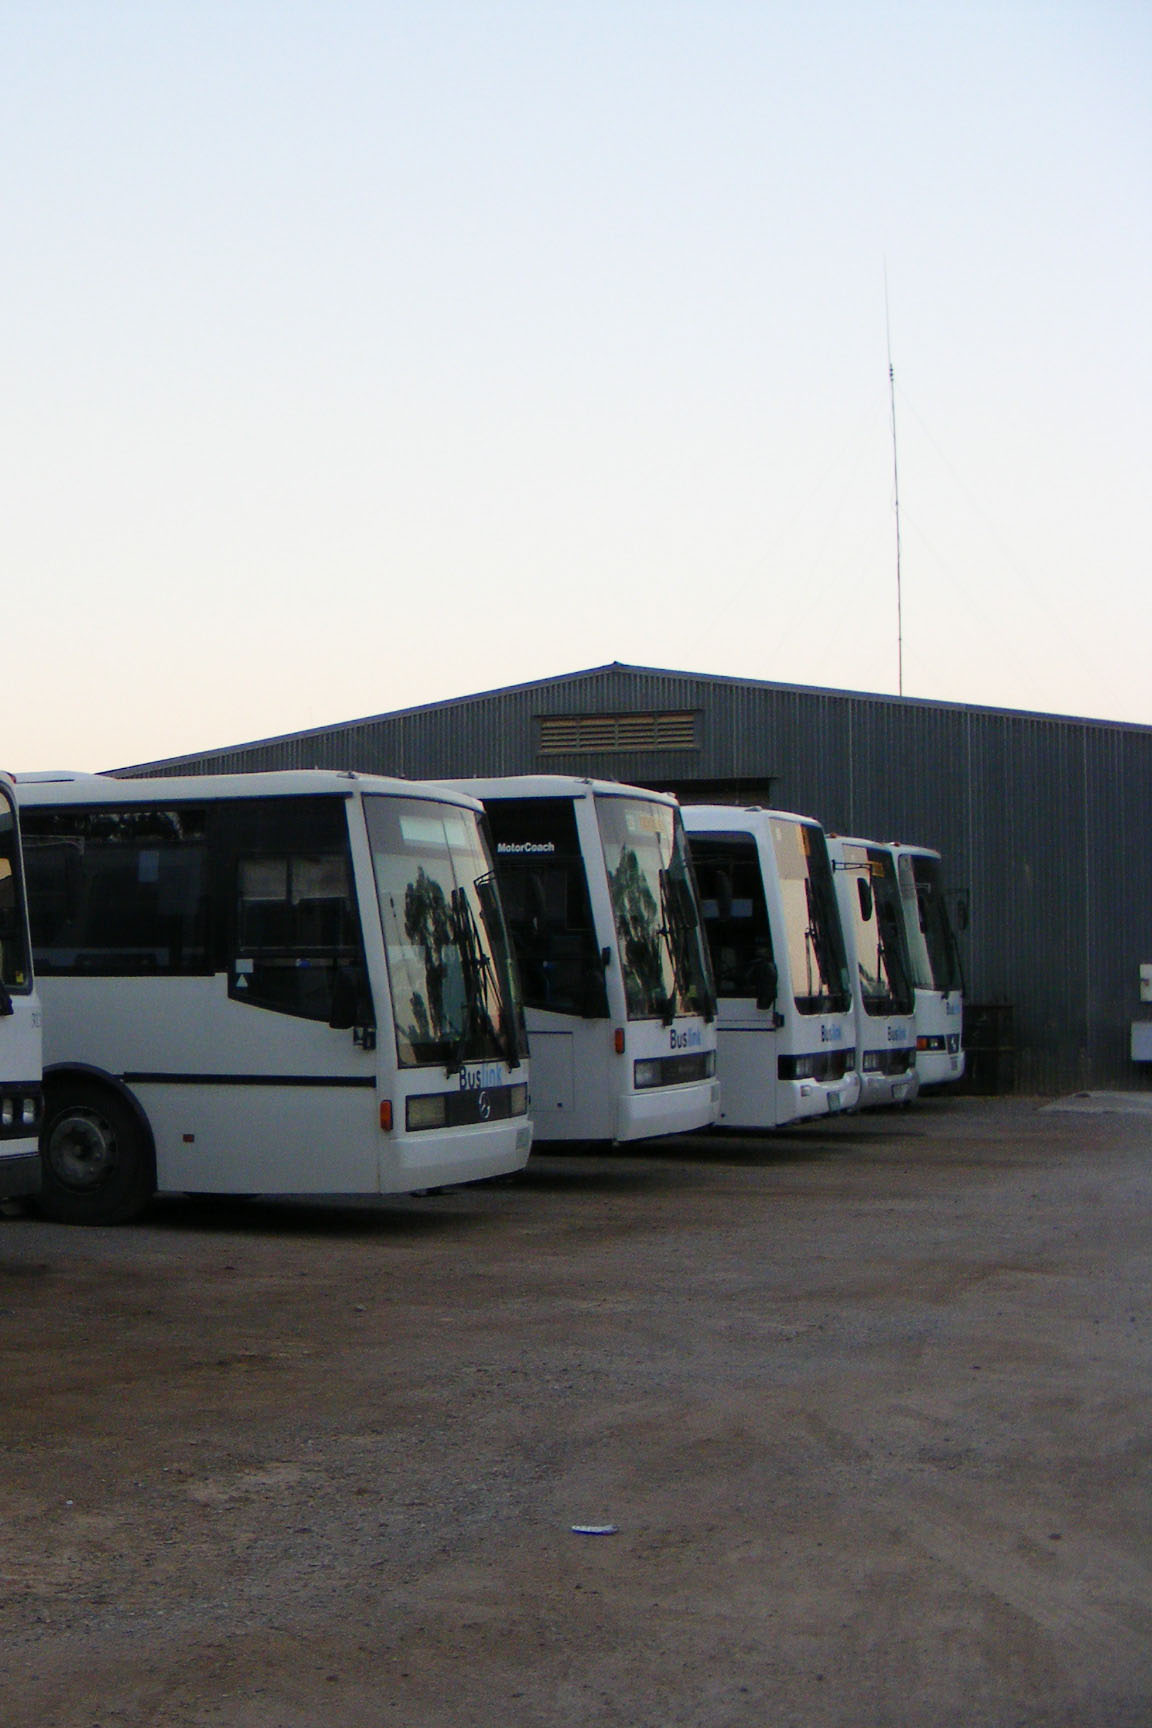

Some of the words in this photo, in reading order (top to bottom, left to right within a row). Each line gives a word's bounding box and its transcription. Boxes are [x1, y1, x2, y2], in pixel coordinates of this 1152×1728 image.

[496, 841, 555, 853] MotorCoach
[669, 1026, 702, 1050] Buslink
[458, 1063, 504, 1091] Buslink
